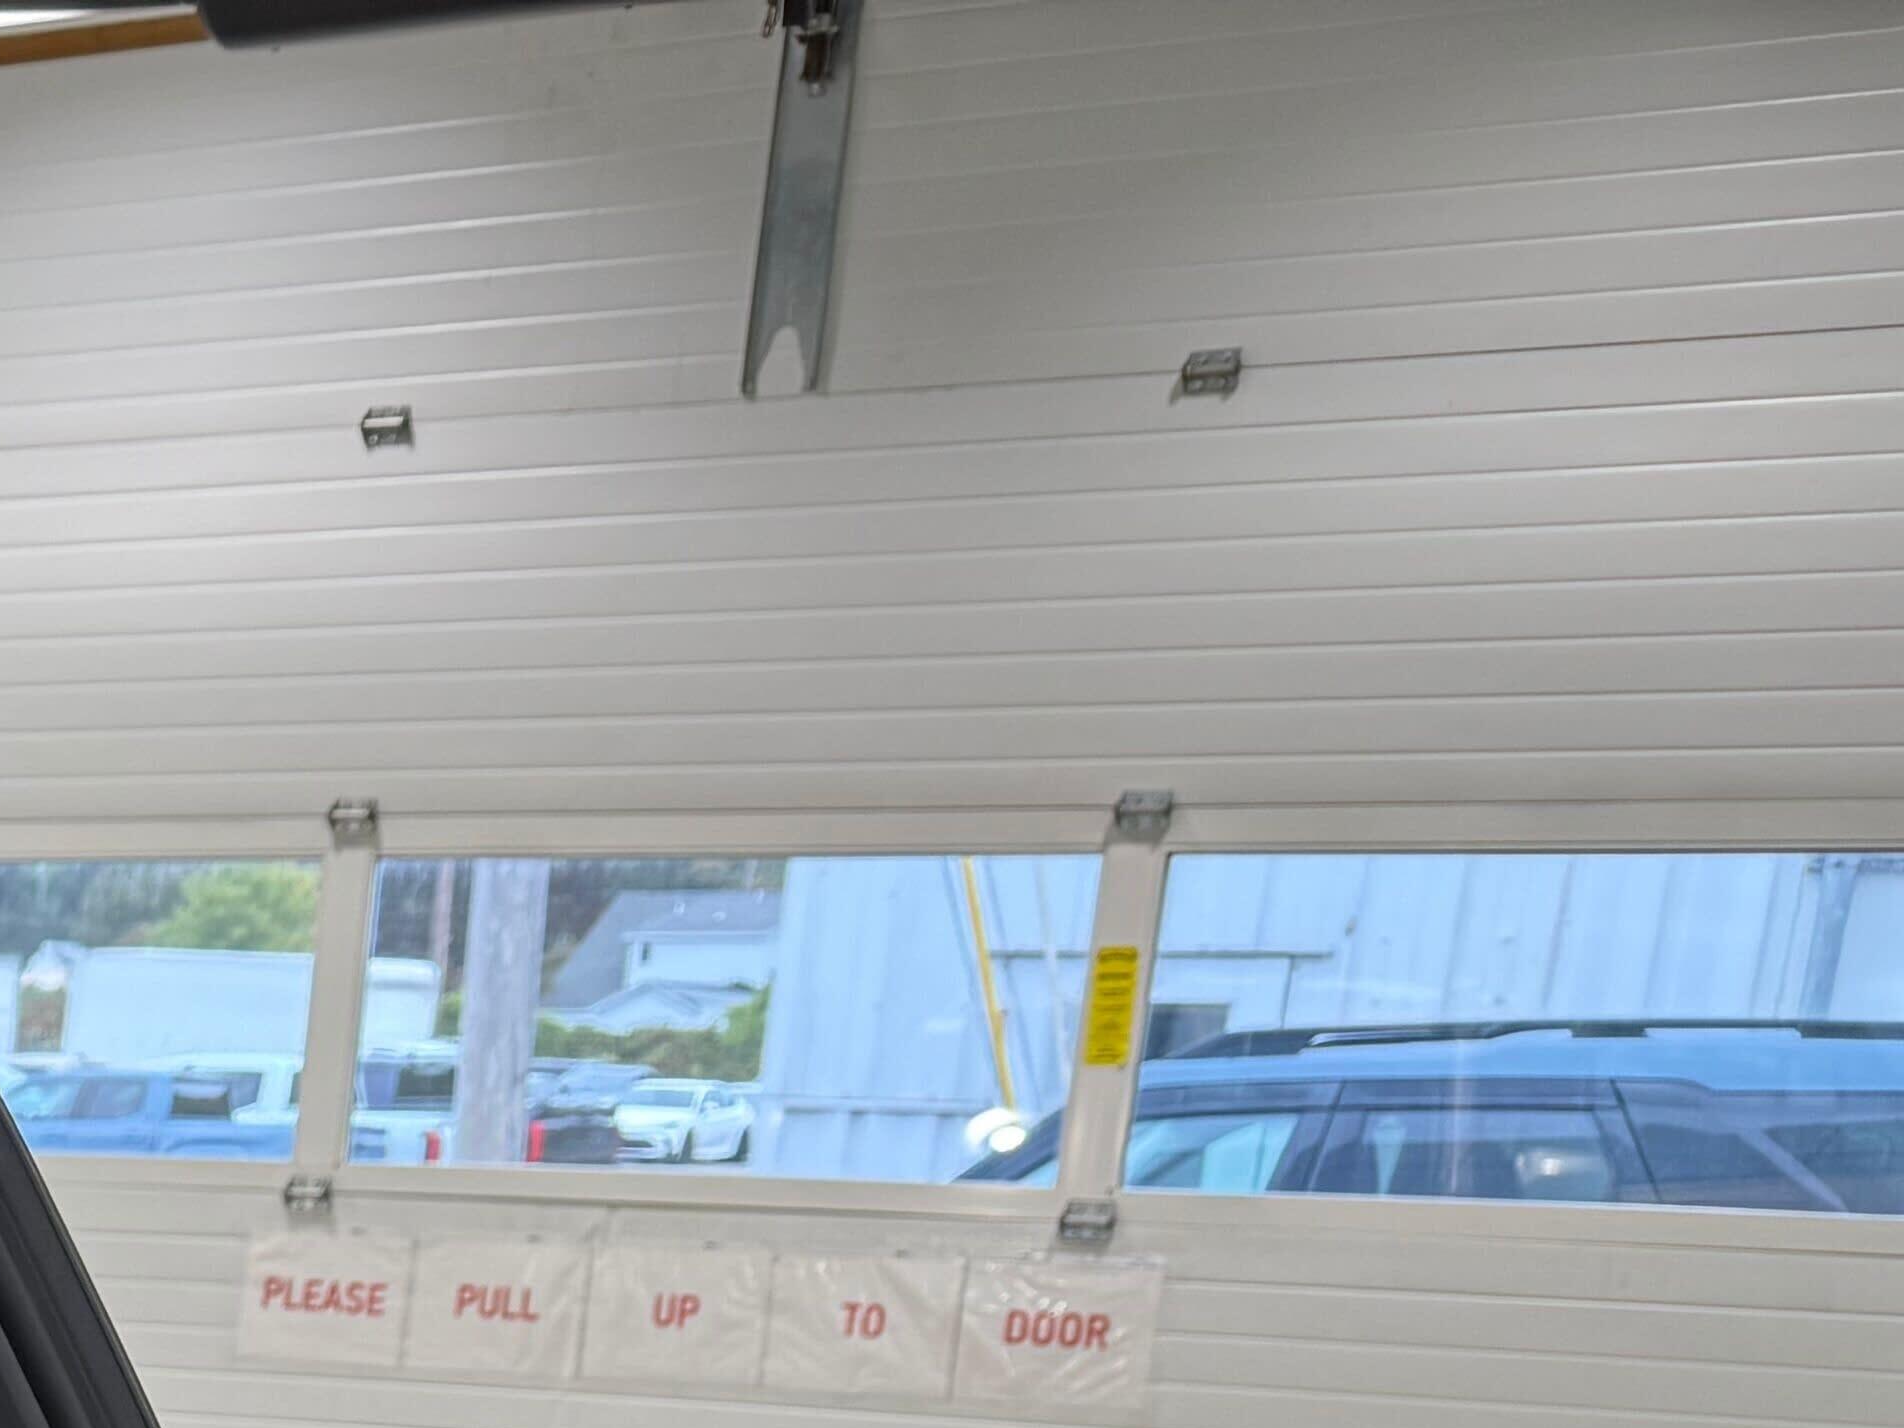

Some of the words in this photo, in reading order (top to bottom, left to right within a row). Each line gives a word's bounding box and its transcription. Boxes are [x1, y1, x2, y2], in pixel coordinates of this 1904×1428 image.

[260, 1274, 387, 1317] PLEASE
[453, 1284, 540, 1323] PULL
[652, 1293, 701, 1329] UP
[841, 1301, 887, 1340] TO
[1003, 1309, 1109, 1351] DOOR
